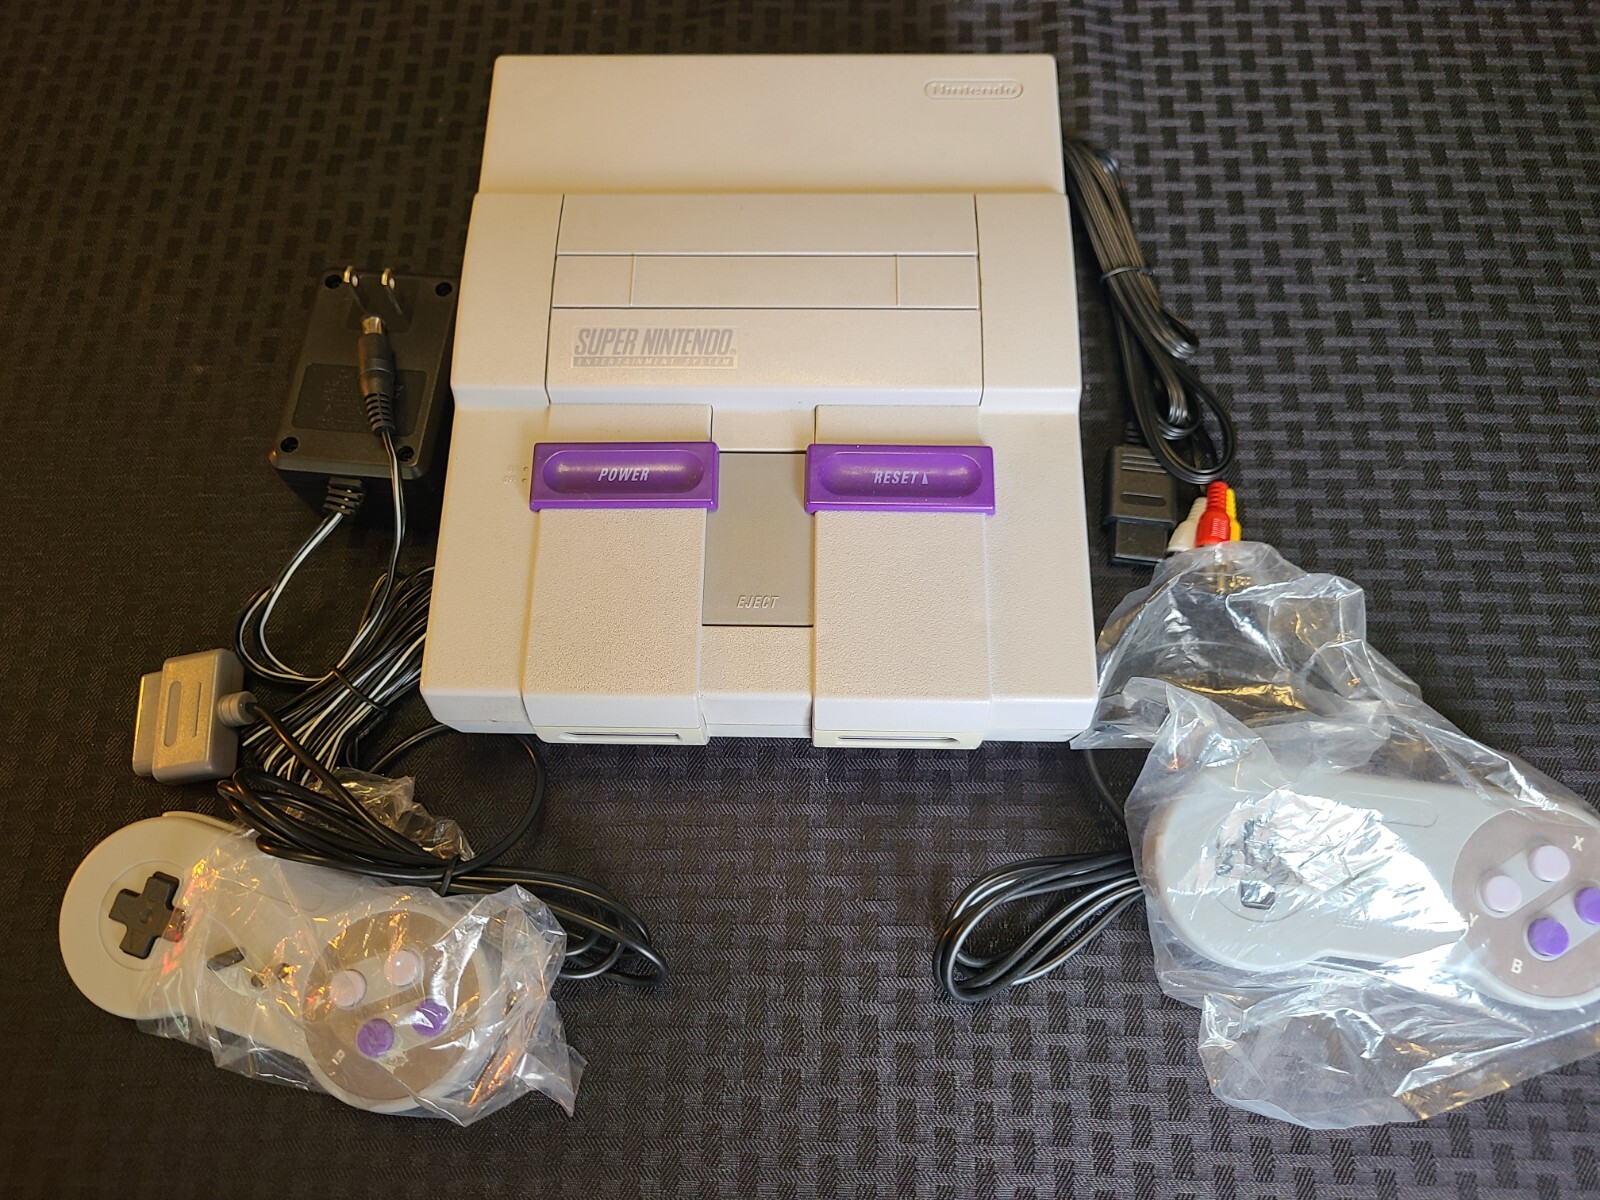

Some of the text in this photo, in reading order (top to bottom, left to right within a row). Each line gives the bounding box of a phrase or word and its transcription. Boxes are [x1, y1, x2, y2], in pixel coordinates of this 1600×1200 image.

[932, 83, 1017, 96] Nintendo
[574, 327, 735, 356] SUPER NINTENDO
[576, 357, 731, 367] ENTERTAINMENT SYSTEM
[597, 467, 651, 482] POWER
[872, 470, 919, 485] RESET
[736, 594, 780, 609] EJECT
[1571, 835, 1585, 851] X
[1469, 912, 1479, 928] Y
[1510, 958, 1523, 974] B
